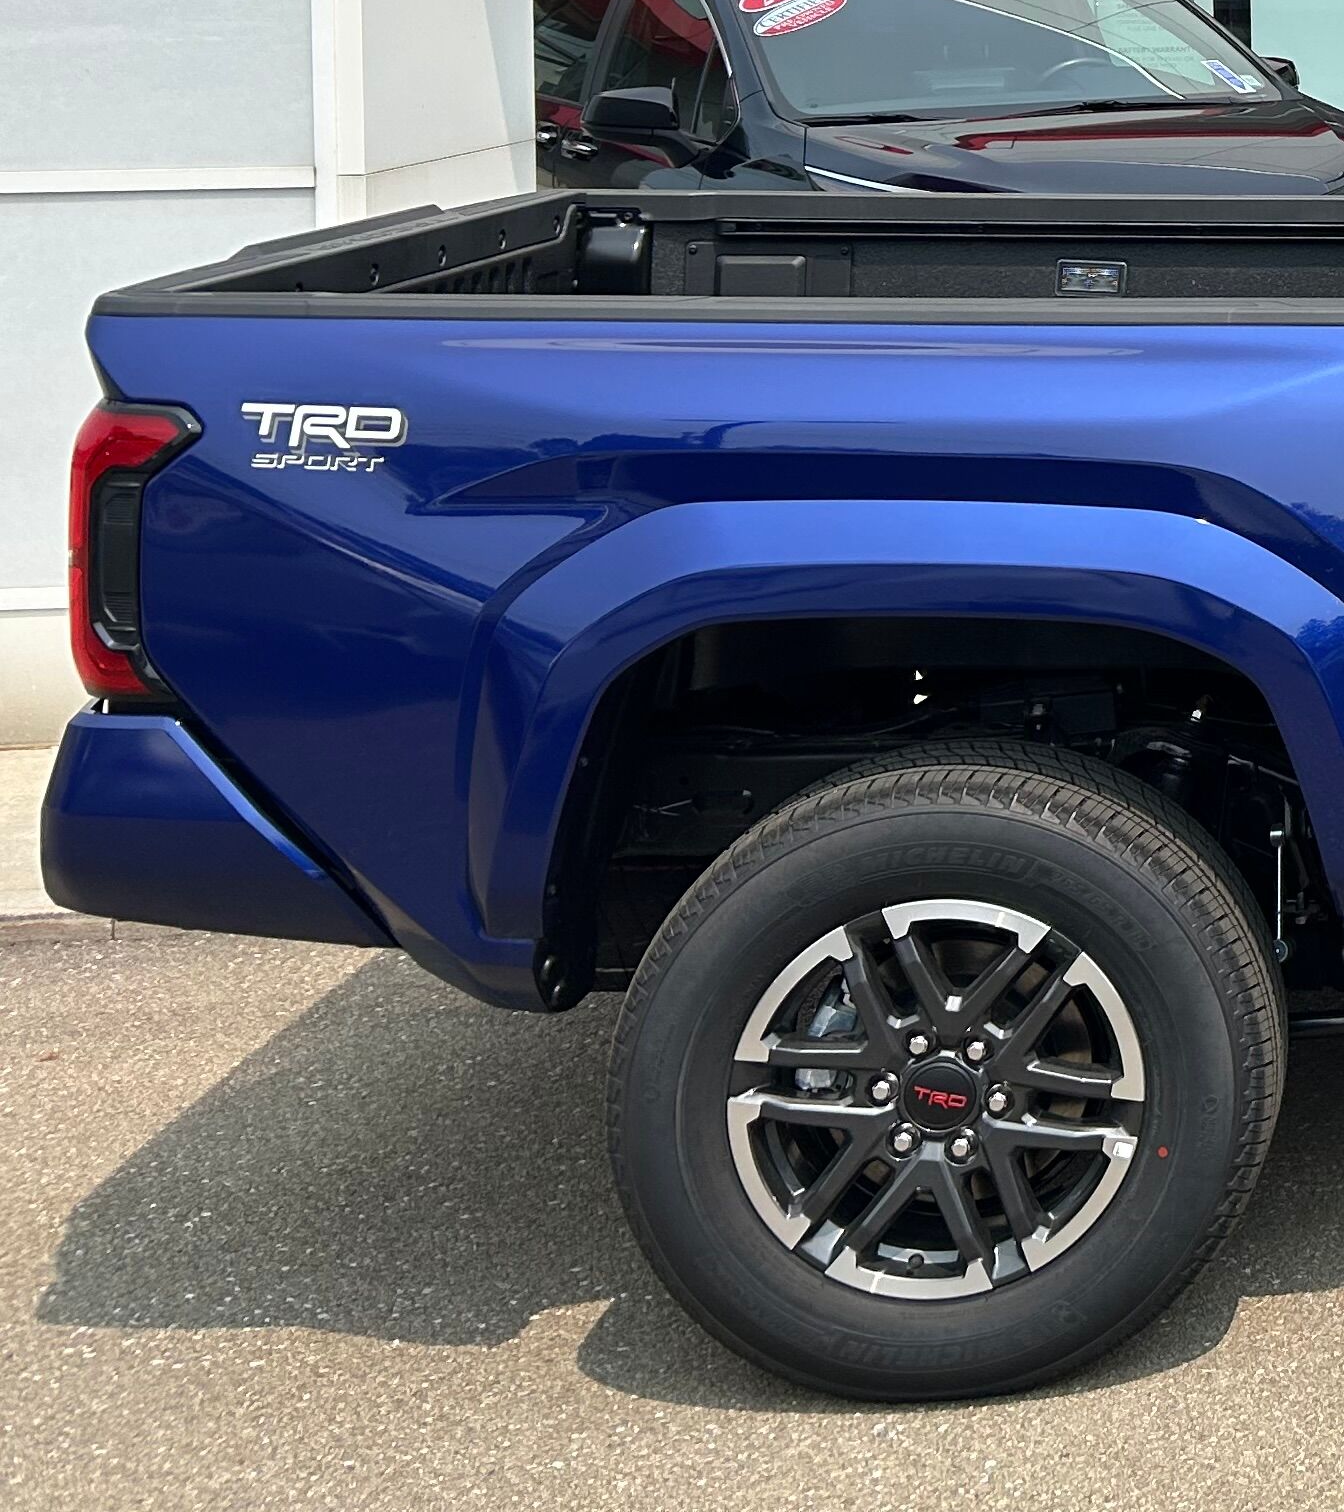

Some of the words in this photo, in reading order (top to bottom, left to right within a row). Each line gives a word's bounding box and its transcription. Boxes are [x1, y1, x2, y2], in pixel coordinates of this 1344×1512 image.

[240, 401, 404, 450] TRD
[250, 453, 385, 473] SPORT
[862, 843, 1029, 876] MICHELIN
[913, 1085, 968, 1109] TRD
